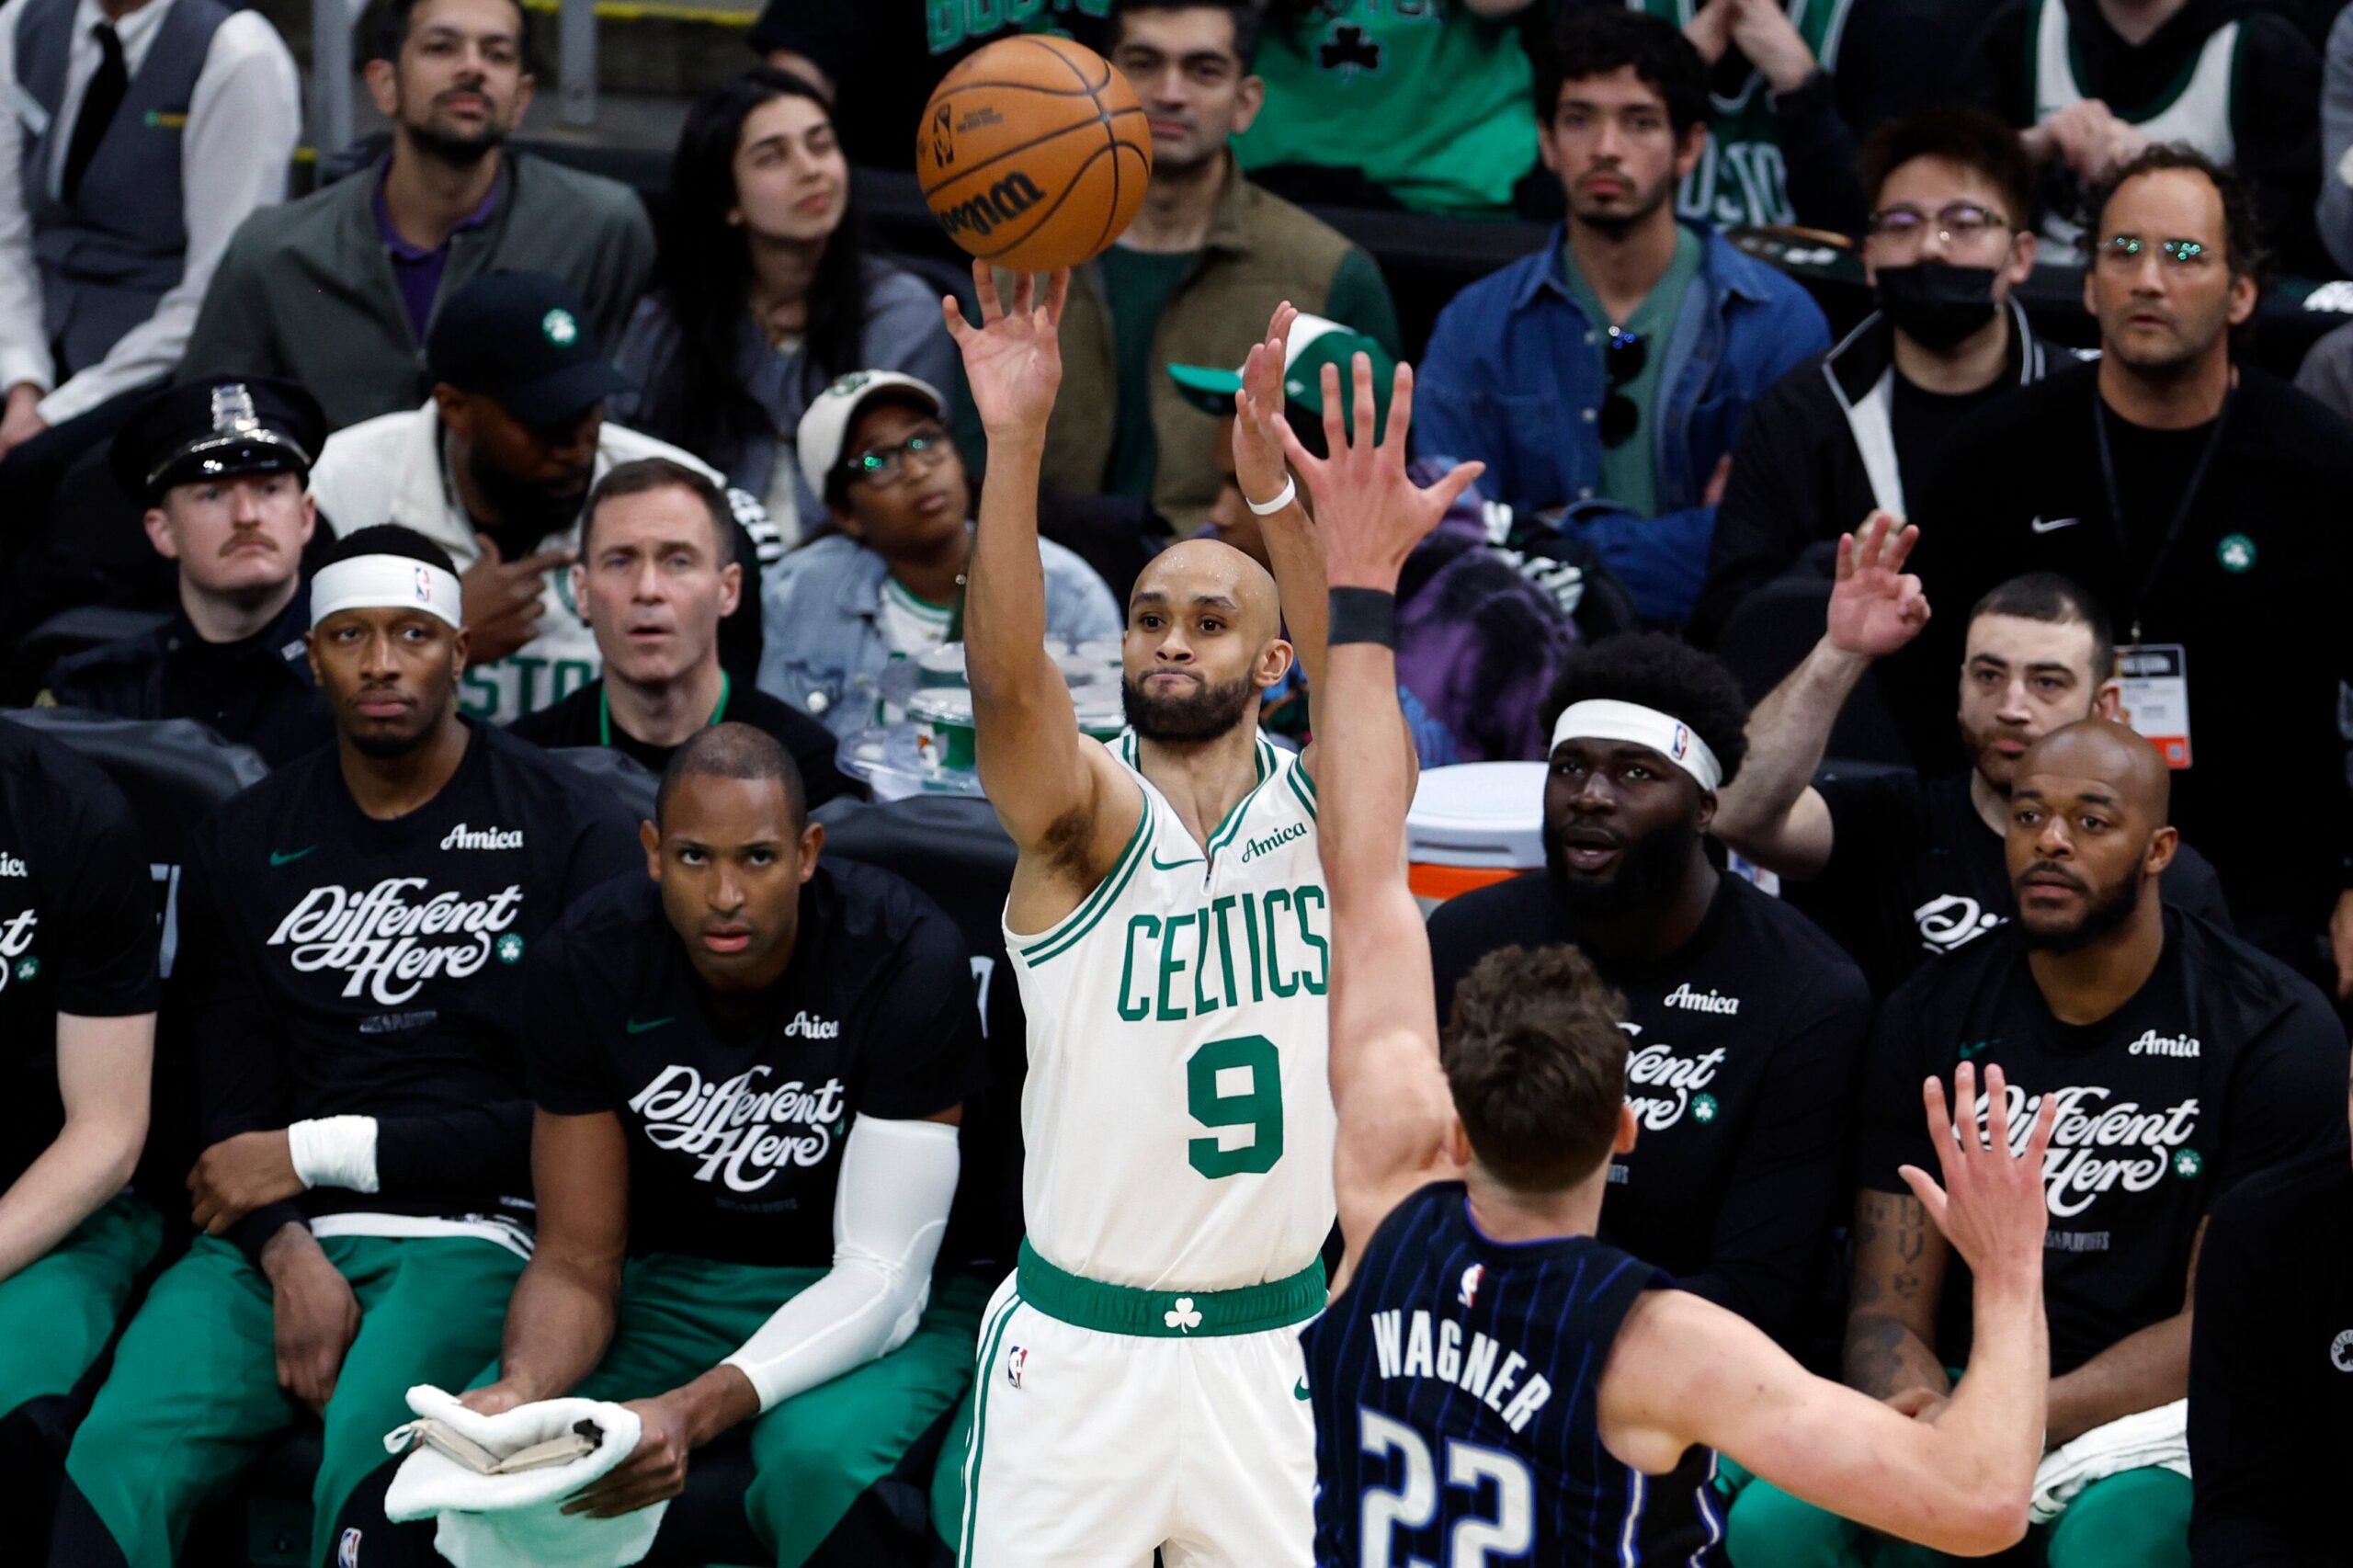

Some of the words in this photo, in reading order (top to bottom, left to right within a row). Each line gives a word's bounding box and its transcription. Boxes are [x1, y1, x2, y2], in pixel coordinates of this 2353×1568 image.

[439, 823, 524, 851] Amica
[1241, 822, 1308, 864] Amica
[267, 877, 524, 972] Different
[341, 930, 492, 1006] Here
[1117, 884, 1328, 1022] CELTICS
[1664, 983, 1740, 1015] Amica
[628, 1064, 845, 1154] Different
[1187, 1034, 1284, 1180] 9
[693, 1123, 831, 1192] Here
[1370, 1309, 1552, 1434] WAGNER
[1358, 1404, 1534, 1568] 22
